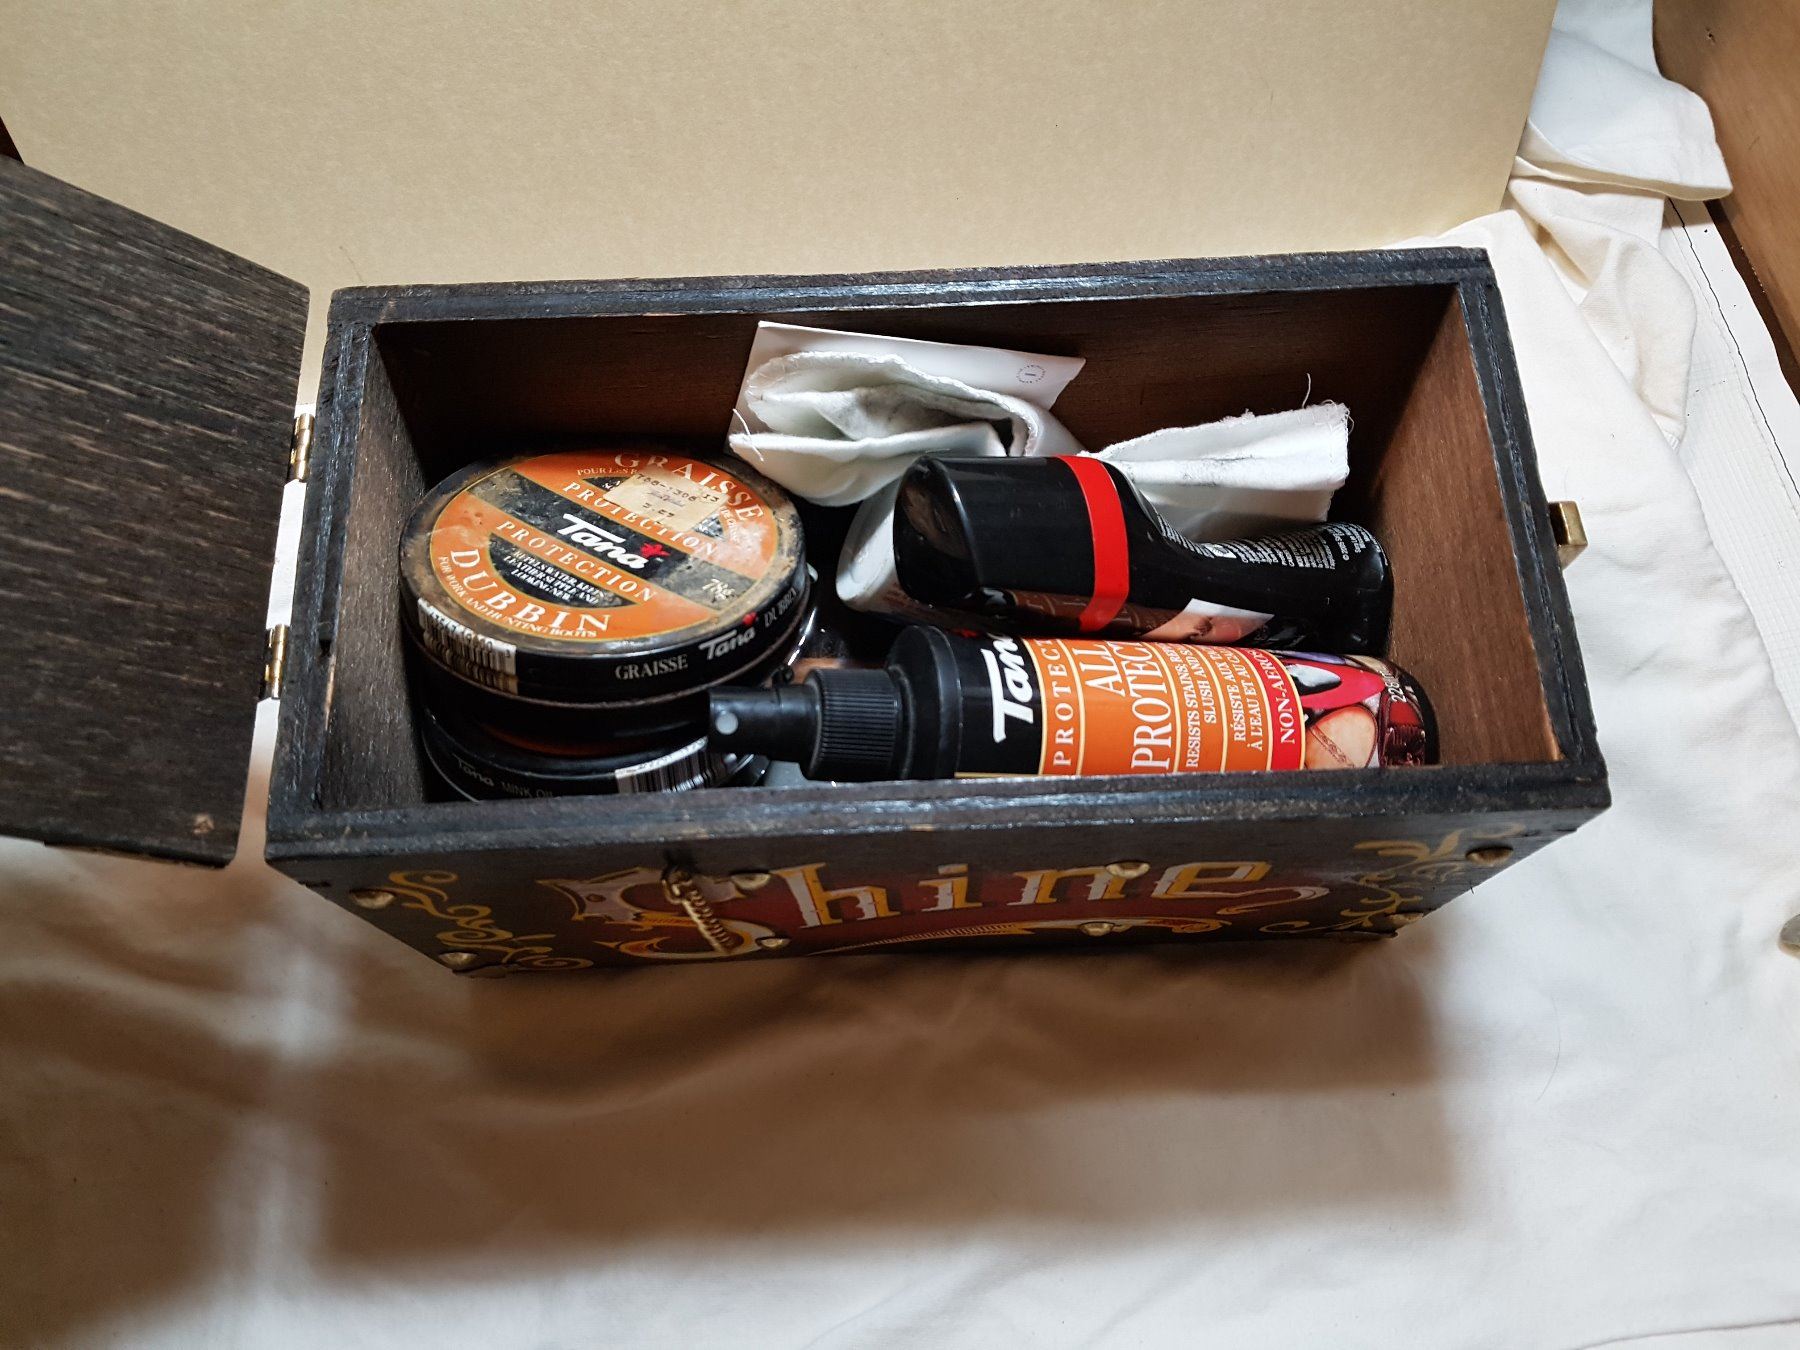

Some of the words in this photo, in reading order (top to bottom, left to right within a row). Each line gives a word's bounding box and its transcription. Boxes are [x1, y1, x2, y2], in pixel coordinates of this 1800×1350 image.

[614, 453, 764, 521] GRAISSE
[497, 520, 656, 602] PROTECTION
[557, 513, 650, 569] Tana
[438, 556, 453, 574] FOR
[446, 574, 467, 598] WORK
[450, 548, 612, 631] DUBBIN
[615, 653, 690, 681] GRAISSE
[698, 627, 757, 660] Tana
[1072, 644, 1125, 697] ALL
[1185, 656, 1207, 678] AND
[1215, 661, 1237, 683] AUX
[1232, 663, 1251, 679] AU
[1197, 679, 1217, 724] SLUSH
[1241, 680, 1257, 696] ET
[1226, 684, 1247, 742] RÉSISTE
[1246, 698, 1263, 737] L'EAU
[1185, 710, 1201, 768] RESISTS
[1247, 740, 1263, 752] À
[452, 753, 495, 787] Tana
[501, 780, 532, 798] MINK
